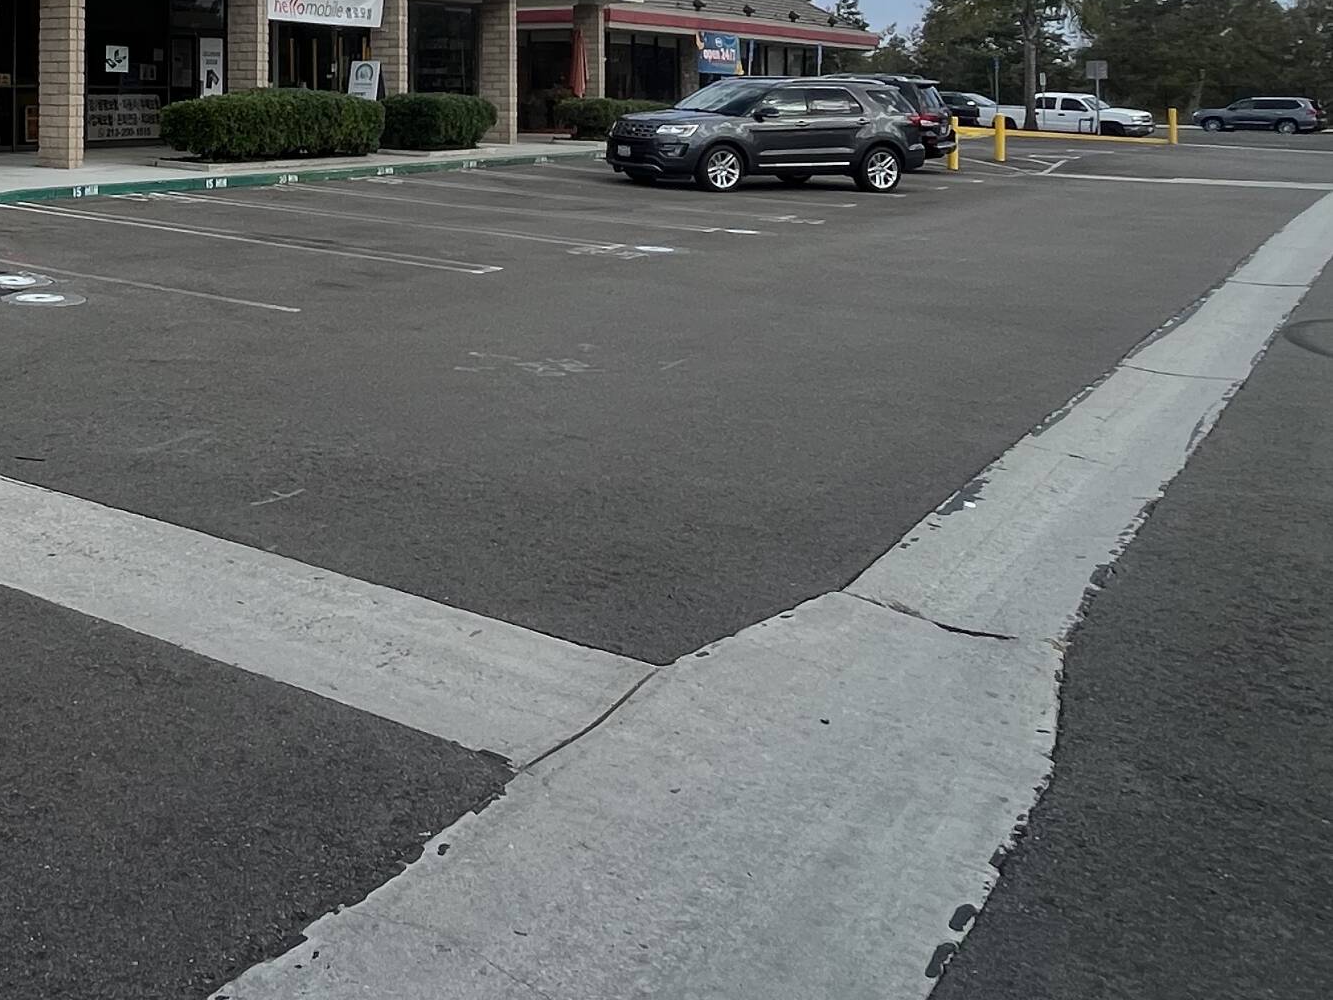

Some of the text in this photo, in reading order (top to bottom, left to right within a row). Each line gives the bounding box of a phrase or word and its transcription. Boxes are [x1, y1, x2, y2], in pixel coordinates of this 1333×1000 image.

[703, 49, 720, 63] open
[206, 178, 214, 189] 15
[72, 186, 82, 198] 15
